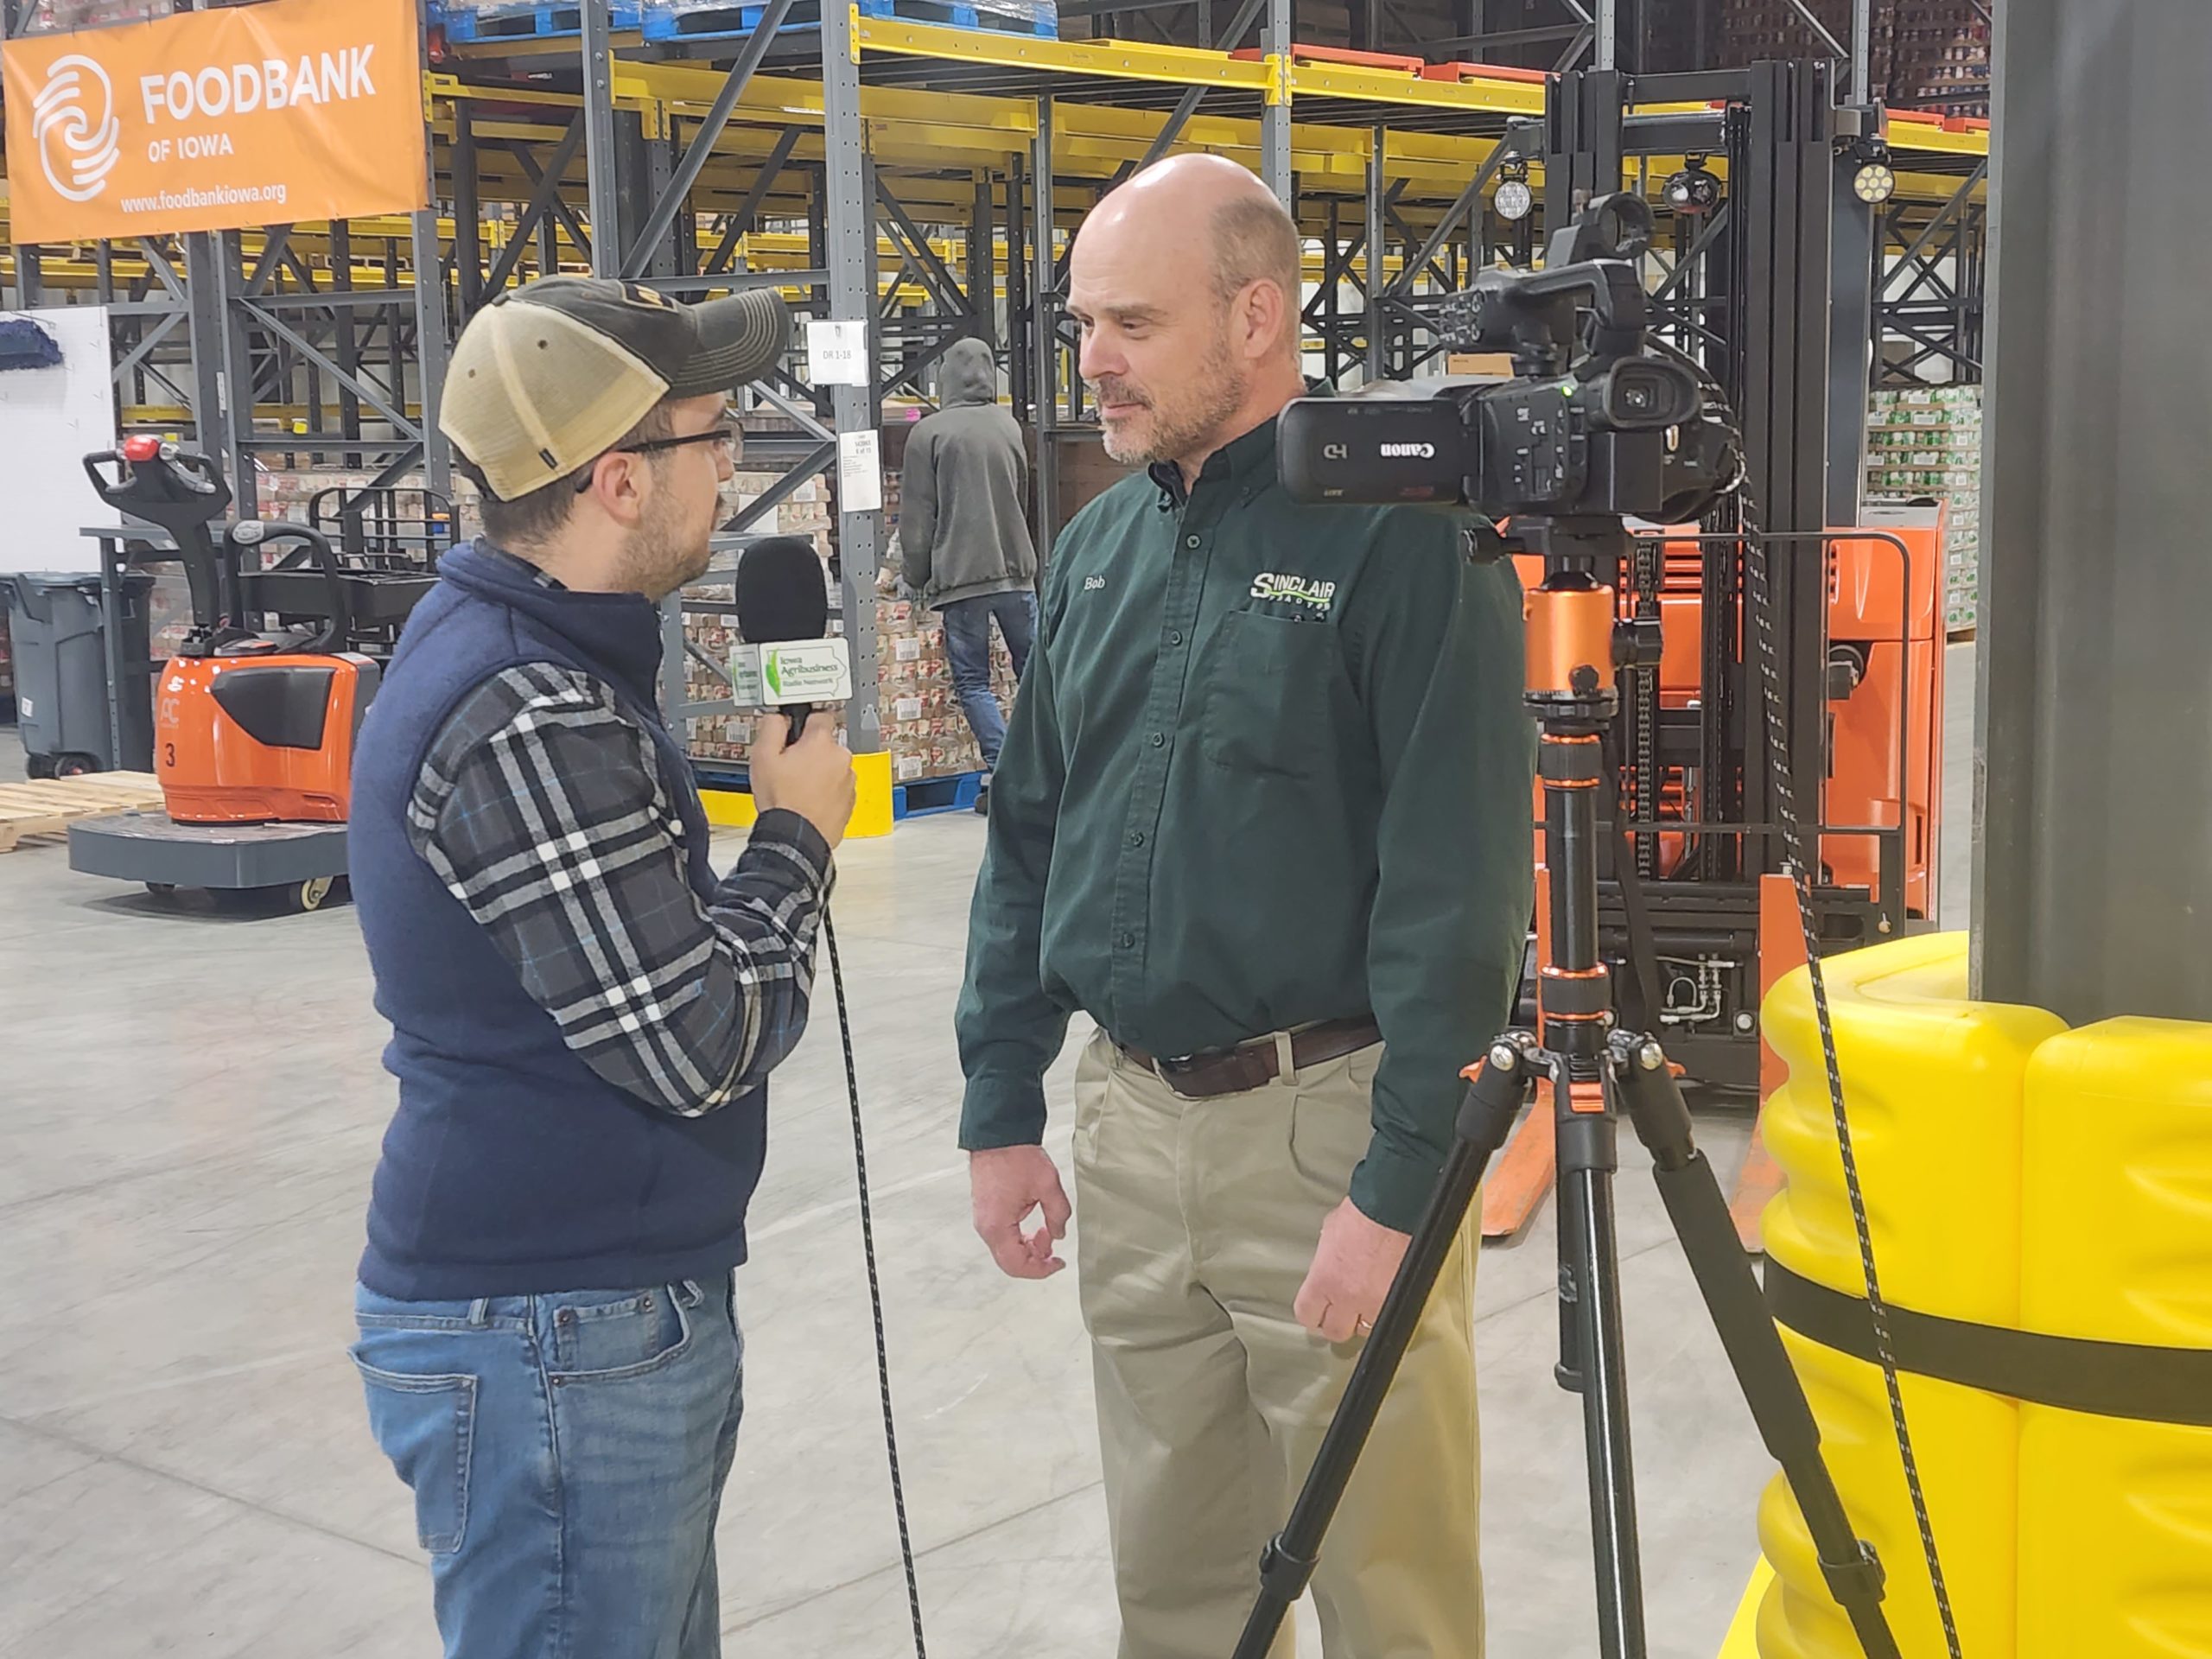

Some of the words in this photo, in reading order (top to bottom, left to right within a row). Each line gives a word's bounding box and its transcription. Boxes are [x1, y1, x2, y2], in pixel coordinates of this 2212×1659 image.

[140, 43, 377, 124] FOODBANK
[148, 138, 171, 162] OF
[178, 133, 234, 160] IOWA
[120, 184, 287, 213] www.foodbankiowa.org
[823, 350, 834, 360] DR
[836, 349, 852, 360] 1-18
[1323, 444, 1347, 459] HD
[1380, 442, 1435, 459] Canon
[1084, 575, 1106, 590] Bob
[1250, 572, 1336, 599] SINCLAIR
[780, 657, 803, 665] Iowa
[781, 664, 838, 677] Agribusiness
[165, 742, 175, 767] 3
